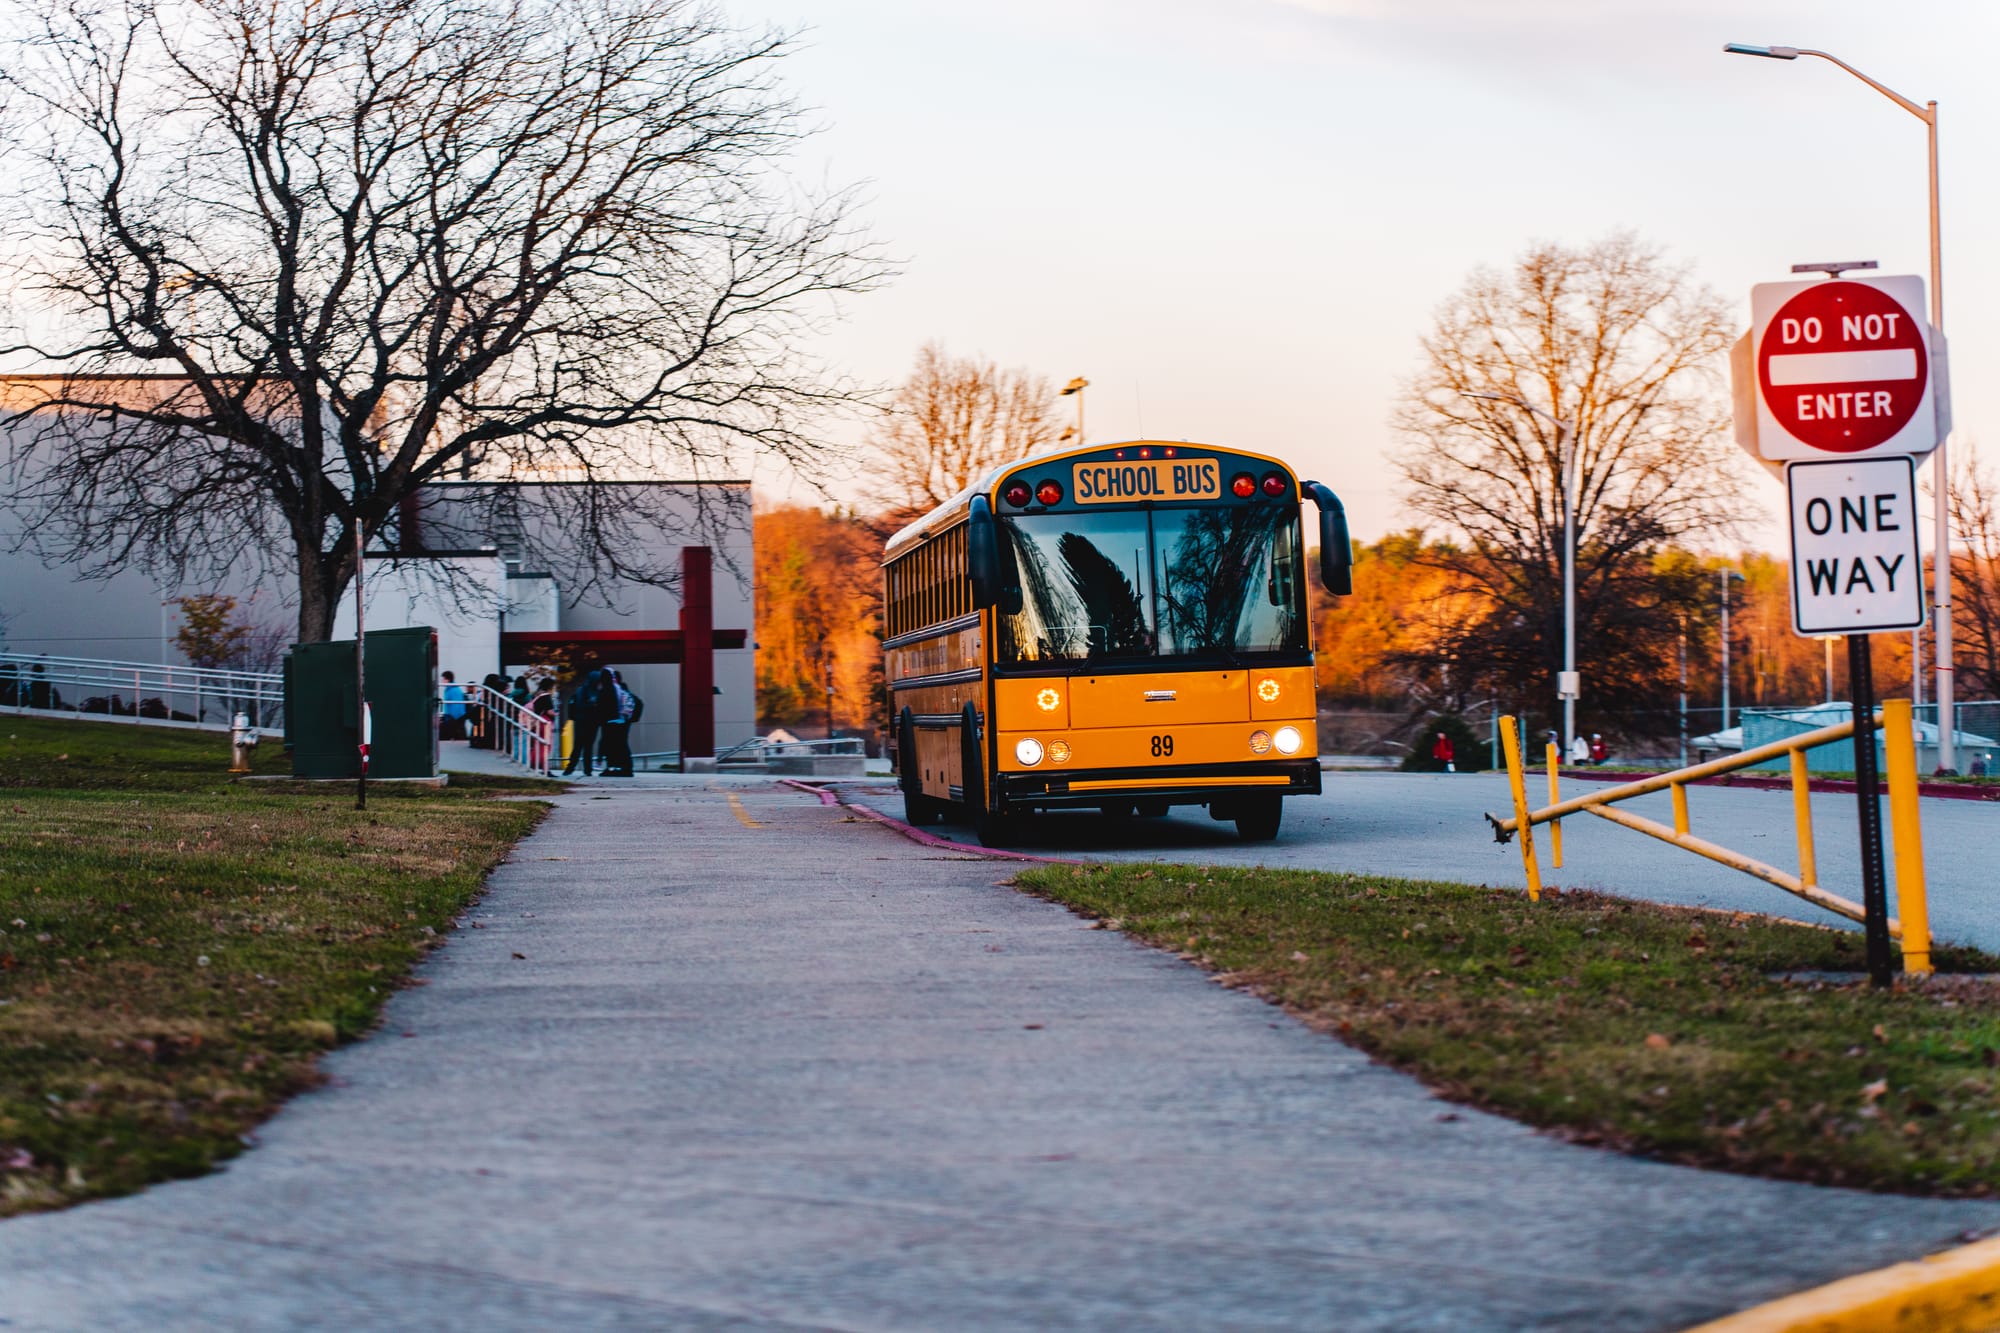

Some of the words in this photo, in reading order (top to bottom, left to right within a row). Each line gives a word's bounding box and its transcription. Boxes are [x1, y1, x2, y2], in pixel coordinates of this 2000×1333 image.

[1782, 317, 1822, 345] DO
[1842, 313, 1900, 342] NOT
[1797, 391, 1893, 420] ENTER
[1079, 467, 1164, 498] SCHOOL
[1173, 464, 1215, 494] BUS
[1805, 494, 1900, 536] ONE
[1807, 554, 1905, 596] WAY
[1151, 735, 1174, 757] 89
